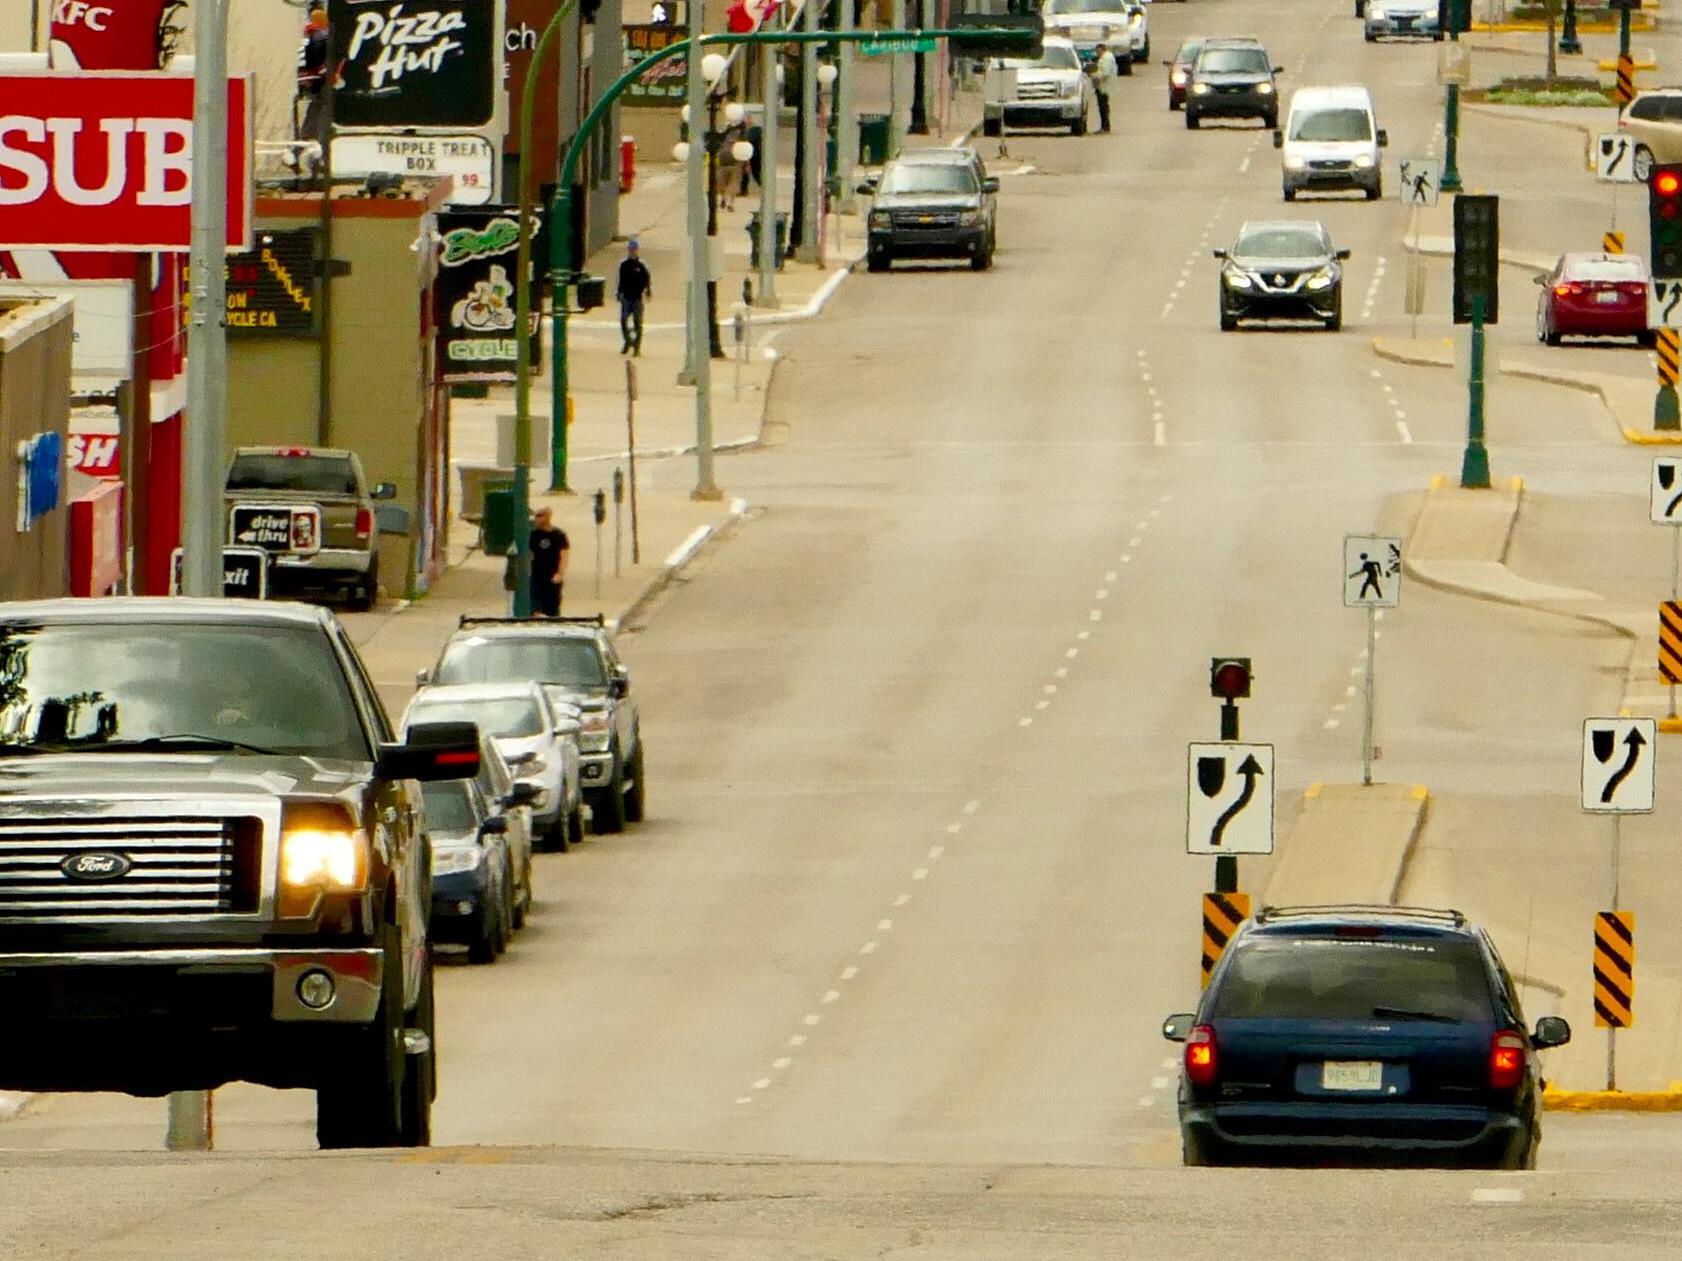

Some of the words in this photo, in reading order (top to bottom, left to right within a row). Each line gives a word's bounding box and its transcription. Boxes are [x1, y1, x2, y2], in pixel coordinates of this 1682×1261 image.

[349, 5, 466, 60] Pizza
[369, 40, 463, 88] Hut
[377, 141, 435, 155] TRIPPLE
[442, 142, 488, 156] TREAT
[0, 115, 192, 206] SUB
[407, 157, 435, 170] BOX
[252, 516, 289, 529] drive
[258, 529, 287, 543] thru
[224, 568, 249, 586] xit
[77, 856, 114, 872] Ford
